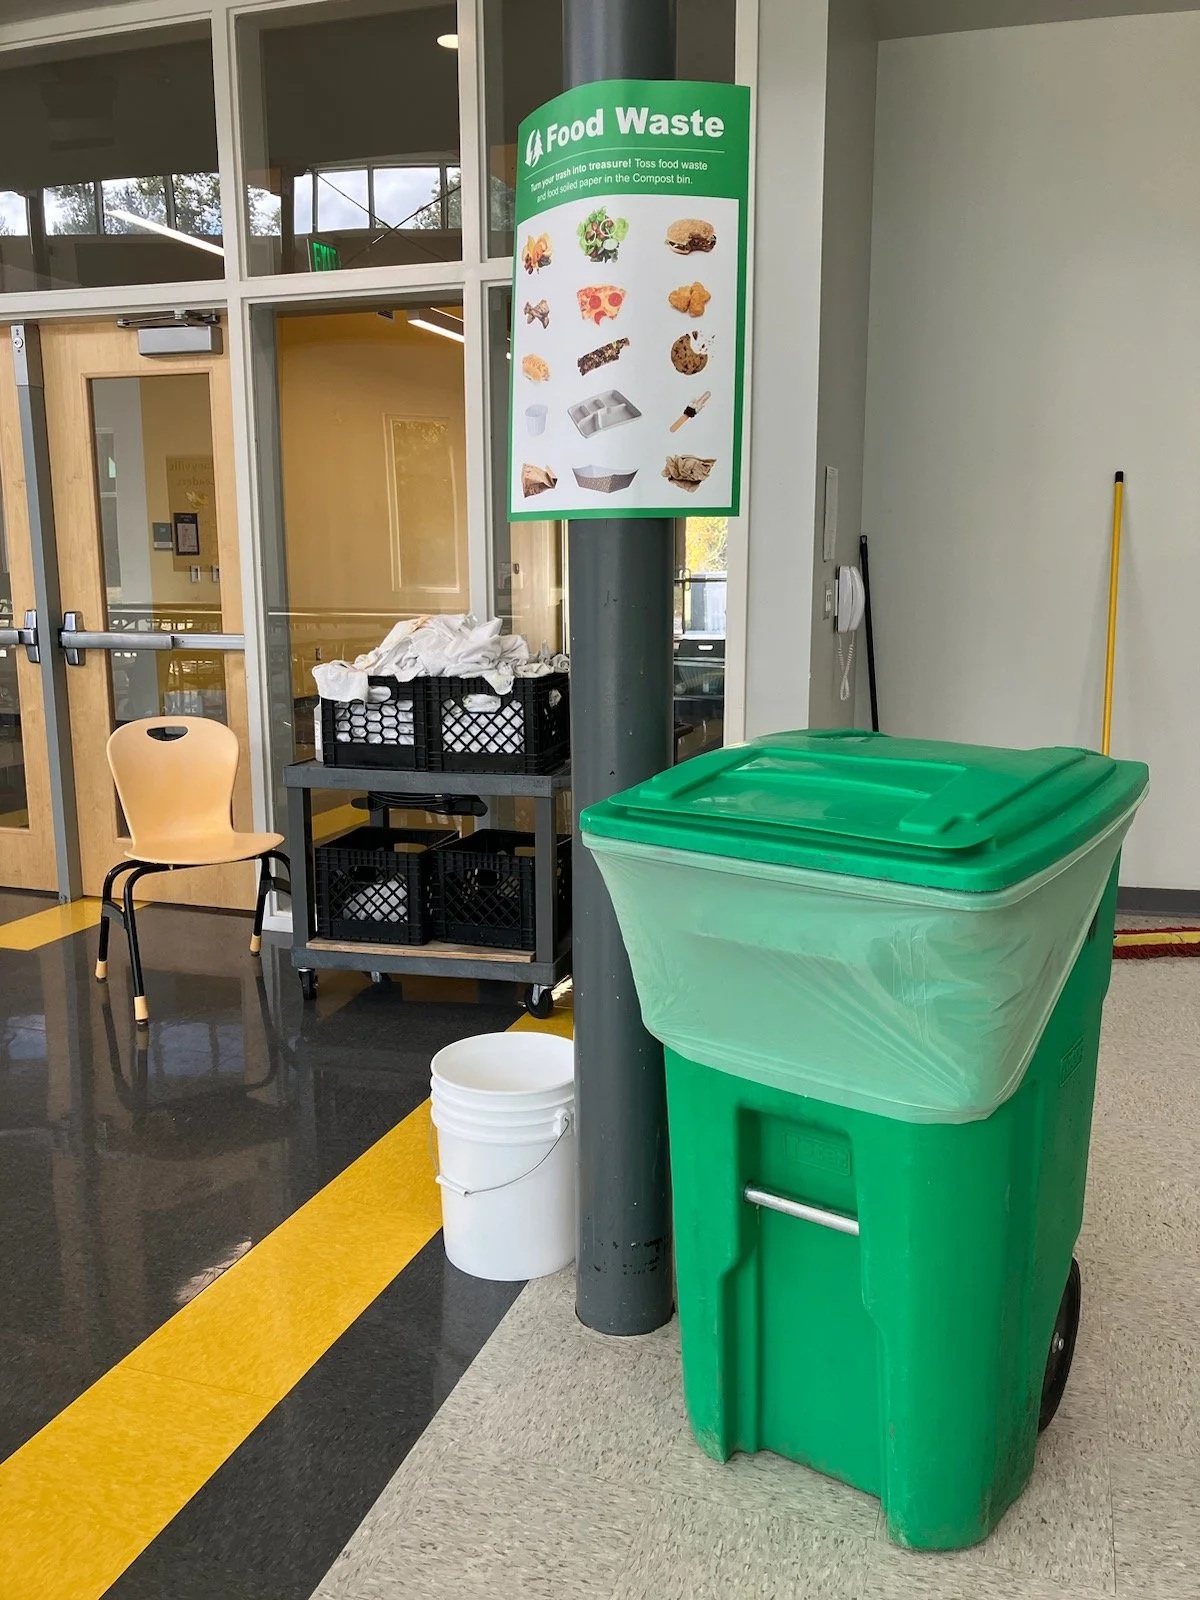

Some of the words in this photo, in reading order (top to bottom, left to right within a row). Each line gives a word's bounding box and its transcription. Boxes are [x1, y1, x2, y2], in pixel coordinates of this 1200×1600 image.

[546, 108, 604, 153] Food
[615, 106, 725, 138] Waste
[530, 181, 542, 192] Turn
[541, 175, 555, 189] your
[555, 167, 571, 181] trash
[572, 163, 587, 176] into
[588, 158, 632, 171] treasure!
[634, 157, 657, 169] Toss
[658, 157, 679, 169] food
[680, 160, 708, 171] waste
[536, 192, 547, 204] and
[546, 186, 559, 199] food
[559, 179, 579, 194] soiled
[579, 175, 602, 189] paper
[604, 173, 613, 183] in
[615, 172, 631, 183] the
[632, 172, 675, 185] Compost
[676, 174, 694, 185] bin.
[313, 242, 337, 272] EXIT
